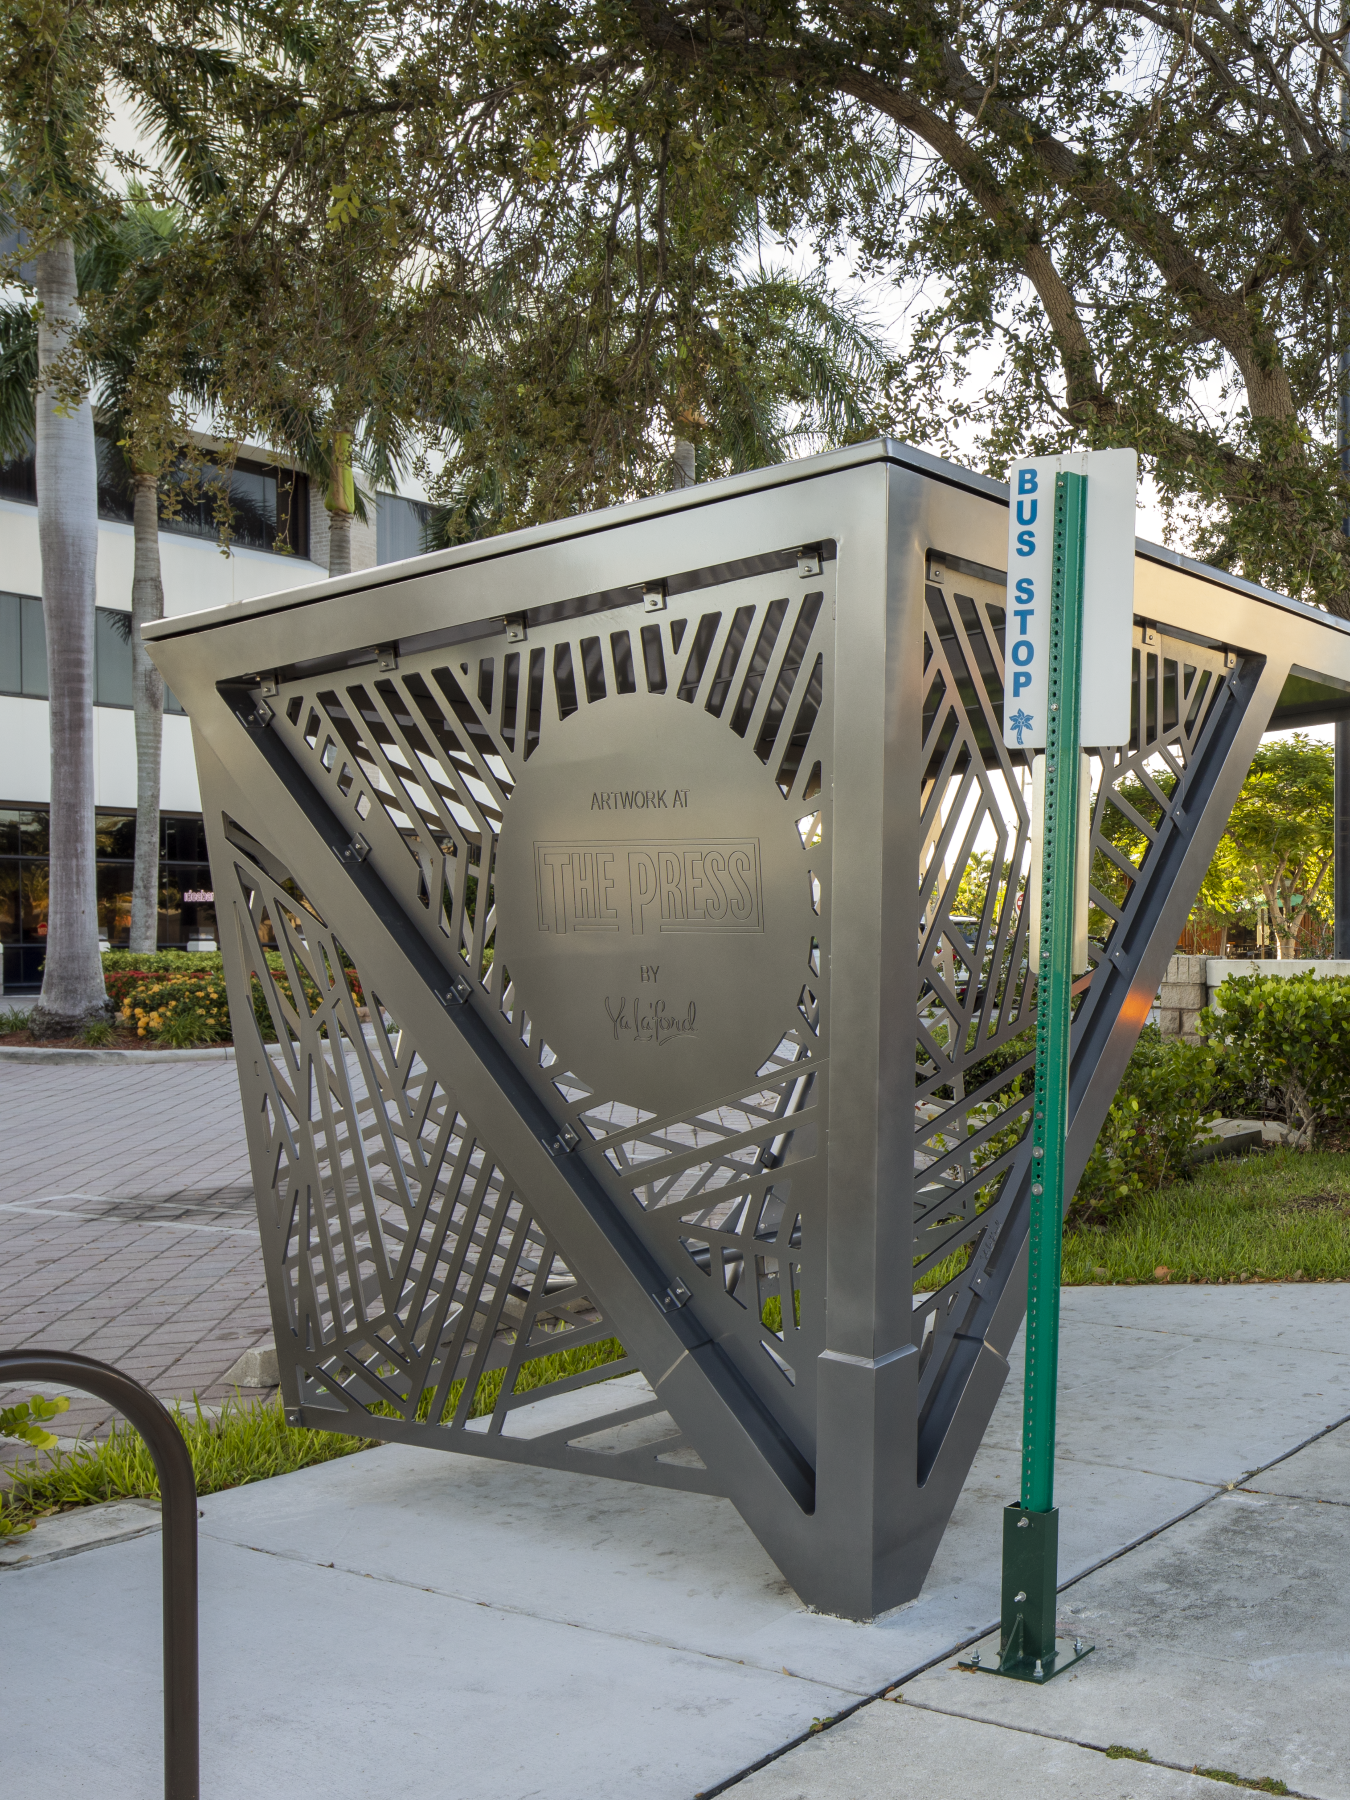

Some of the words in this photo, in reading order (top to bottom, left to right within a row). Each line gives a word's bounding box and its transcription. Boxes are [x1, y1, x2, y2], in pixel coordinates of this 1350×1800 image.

[1016, 468, 1039, 557] BUS
[1011, 577, 1035, 698] STOP
[591, 789, 668, 811] ARTWORK
[673, 788, 691, 809] AT
[544, 853, 617, 935] THE
[628, 851, 753, 935] PRESS
[640, 964, 660, 984] BY
